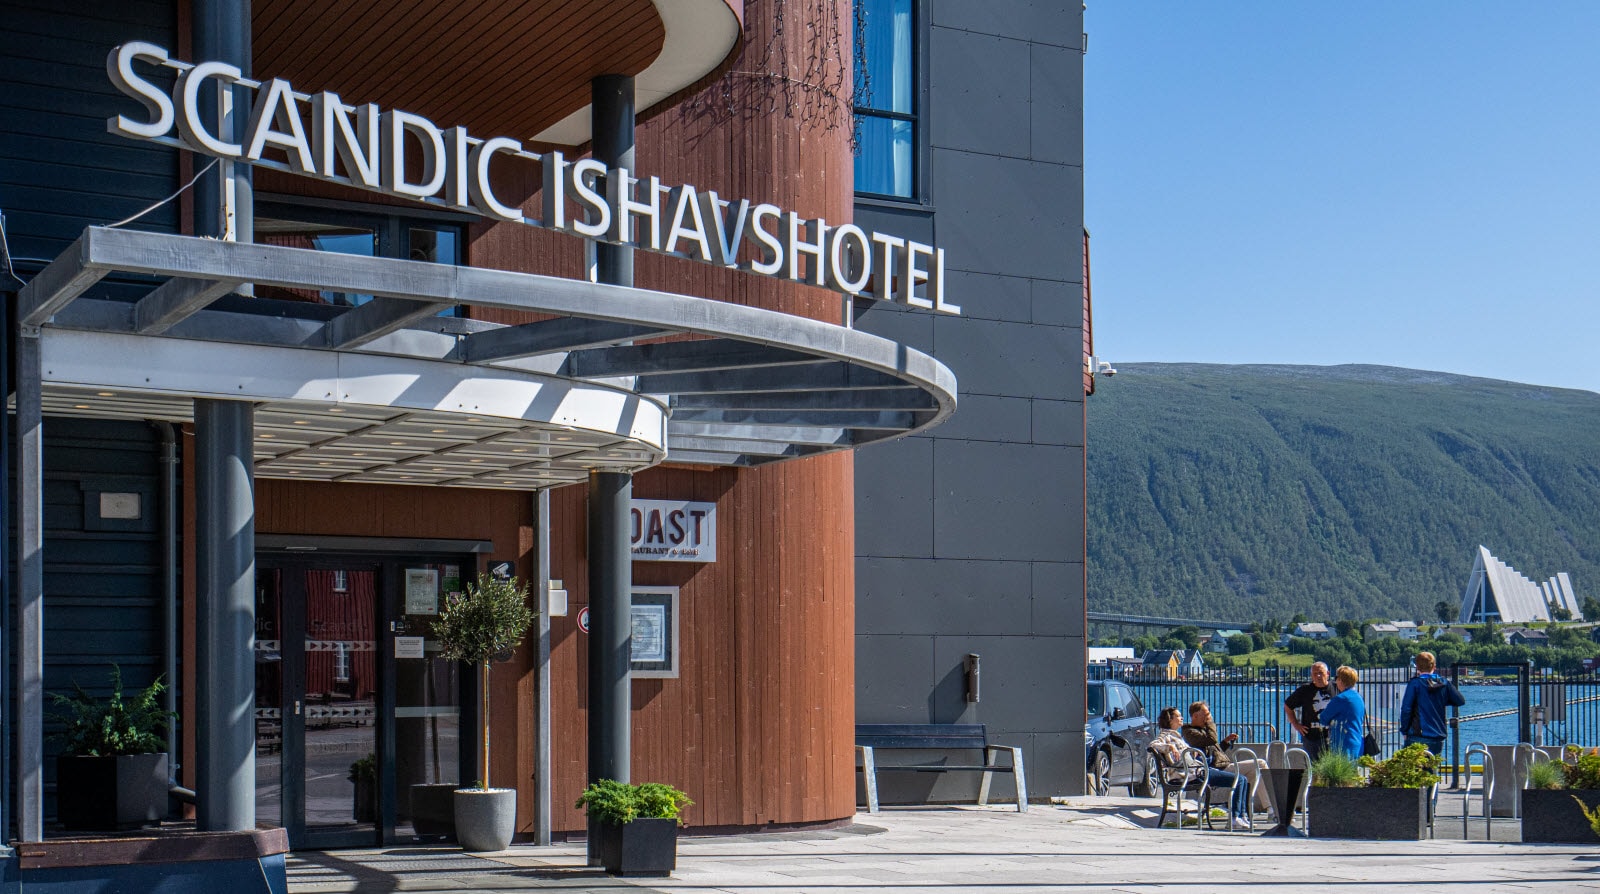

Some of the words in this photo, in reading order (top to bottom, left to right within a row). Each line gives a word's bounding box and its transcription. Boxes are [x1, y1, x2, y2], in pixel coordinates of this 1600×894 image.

[108, 41, 523, 220] SCANDIC
[547, 151, 961, 314] ISHAVSHOTEL
[631, 508, 706, 544] OAST
[631, 547, 669, 555] AURANT
